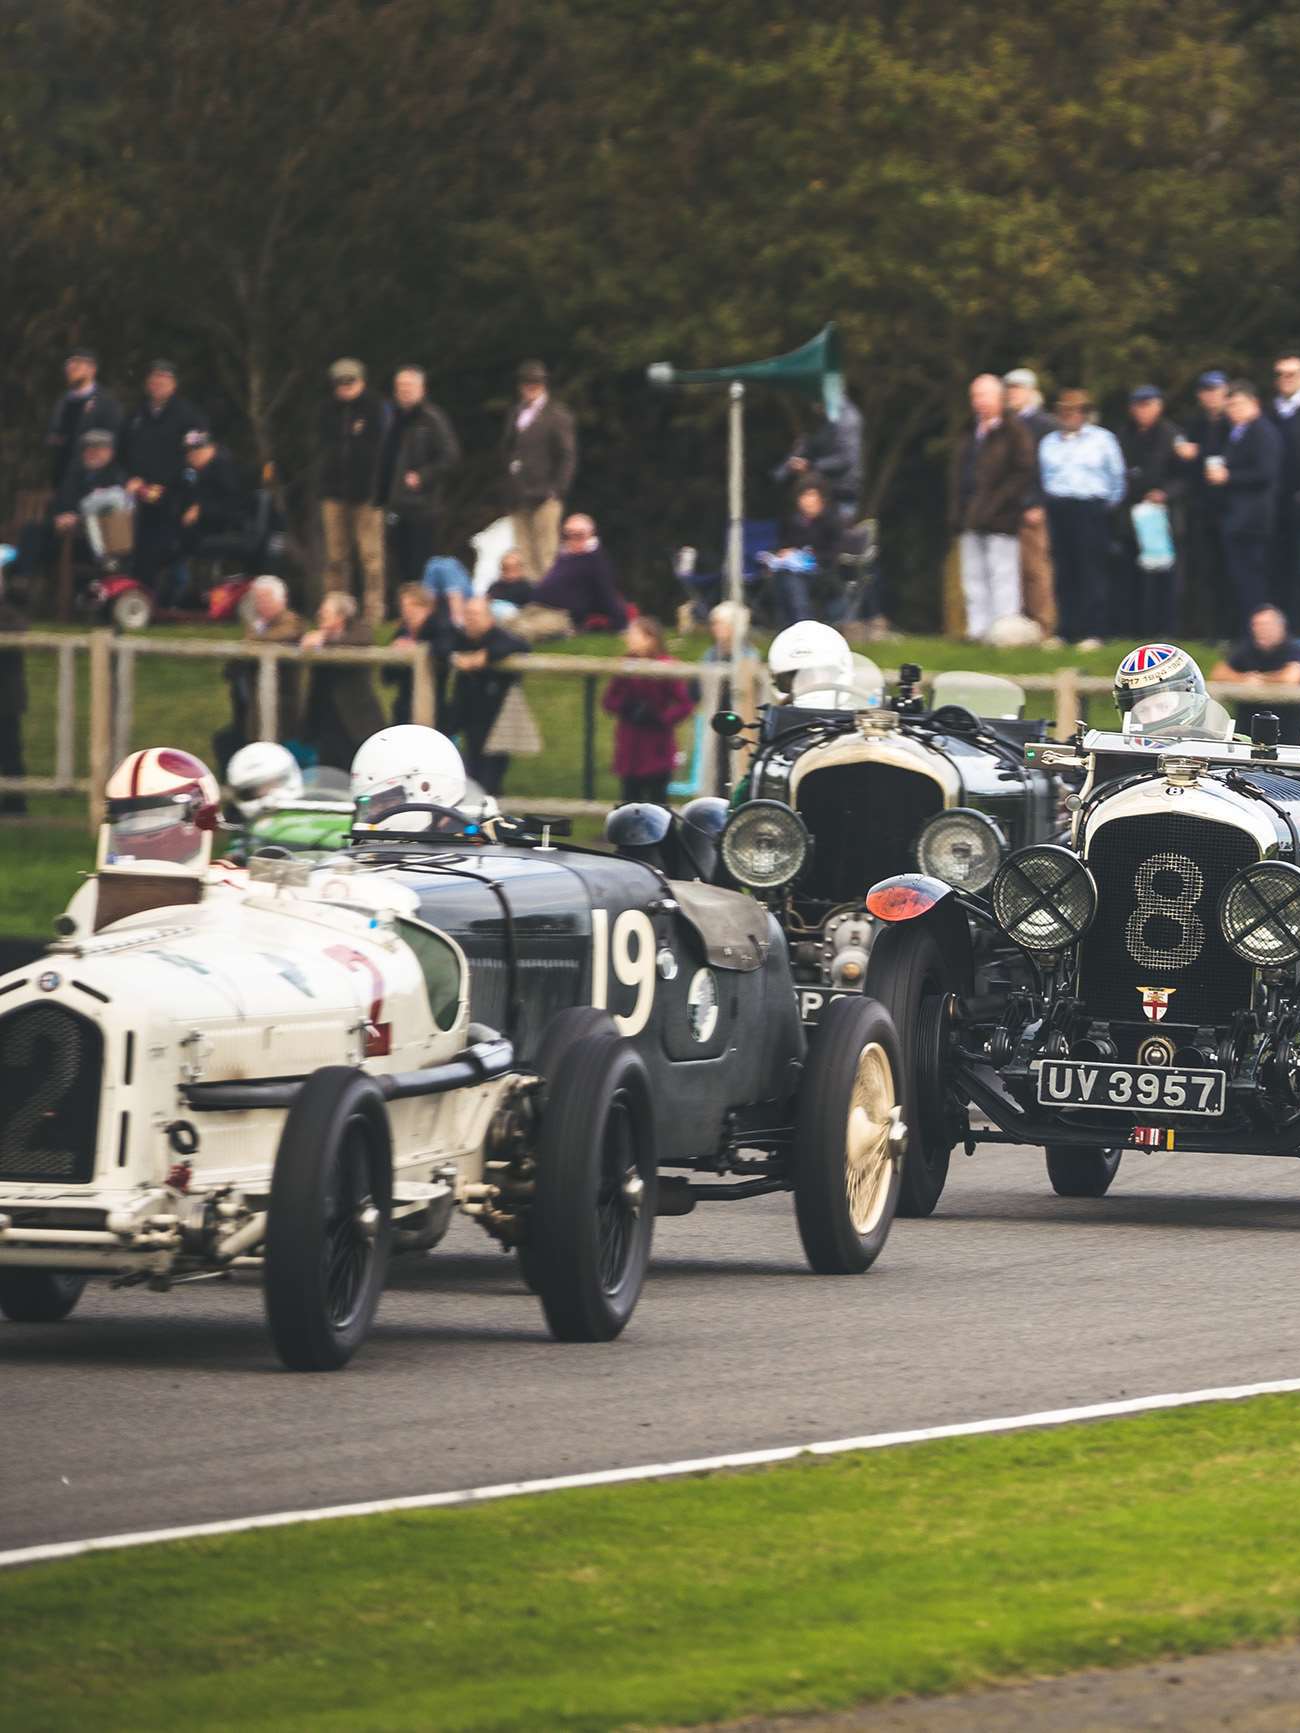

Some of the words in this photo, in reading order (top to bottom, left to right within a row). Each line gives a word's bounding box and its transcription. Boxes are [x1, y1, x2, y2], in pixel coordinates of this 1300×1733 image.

[591, 908, 656, 1037] 19
[1126, 852, 1204, 970] 8
[2, 1008, 81, 1174] 2
[1049, 1067, 1099, 1101] UV
[1108, 1071, 1215, 1108] 3957
